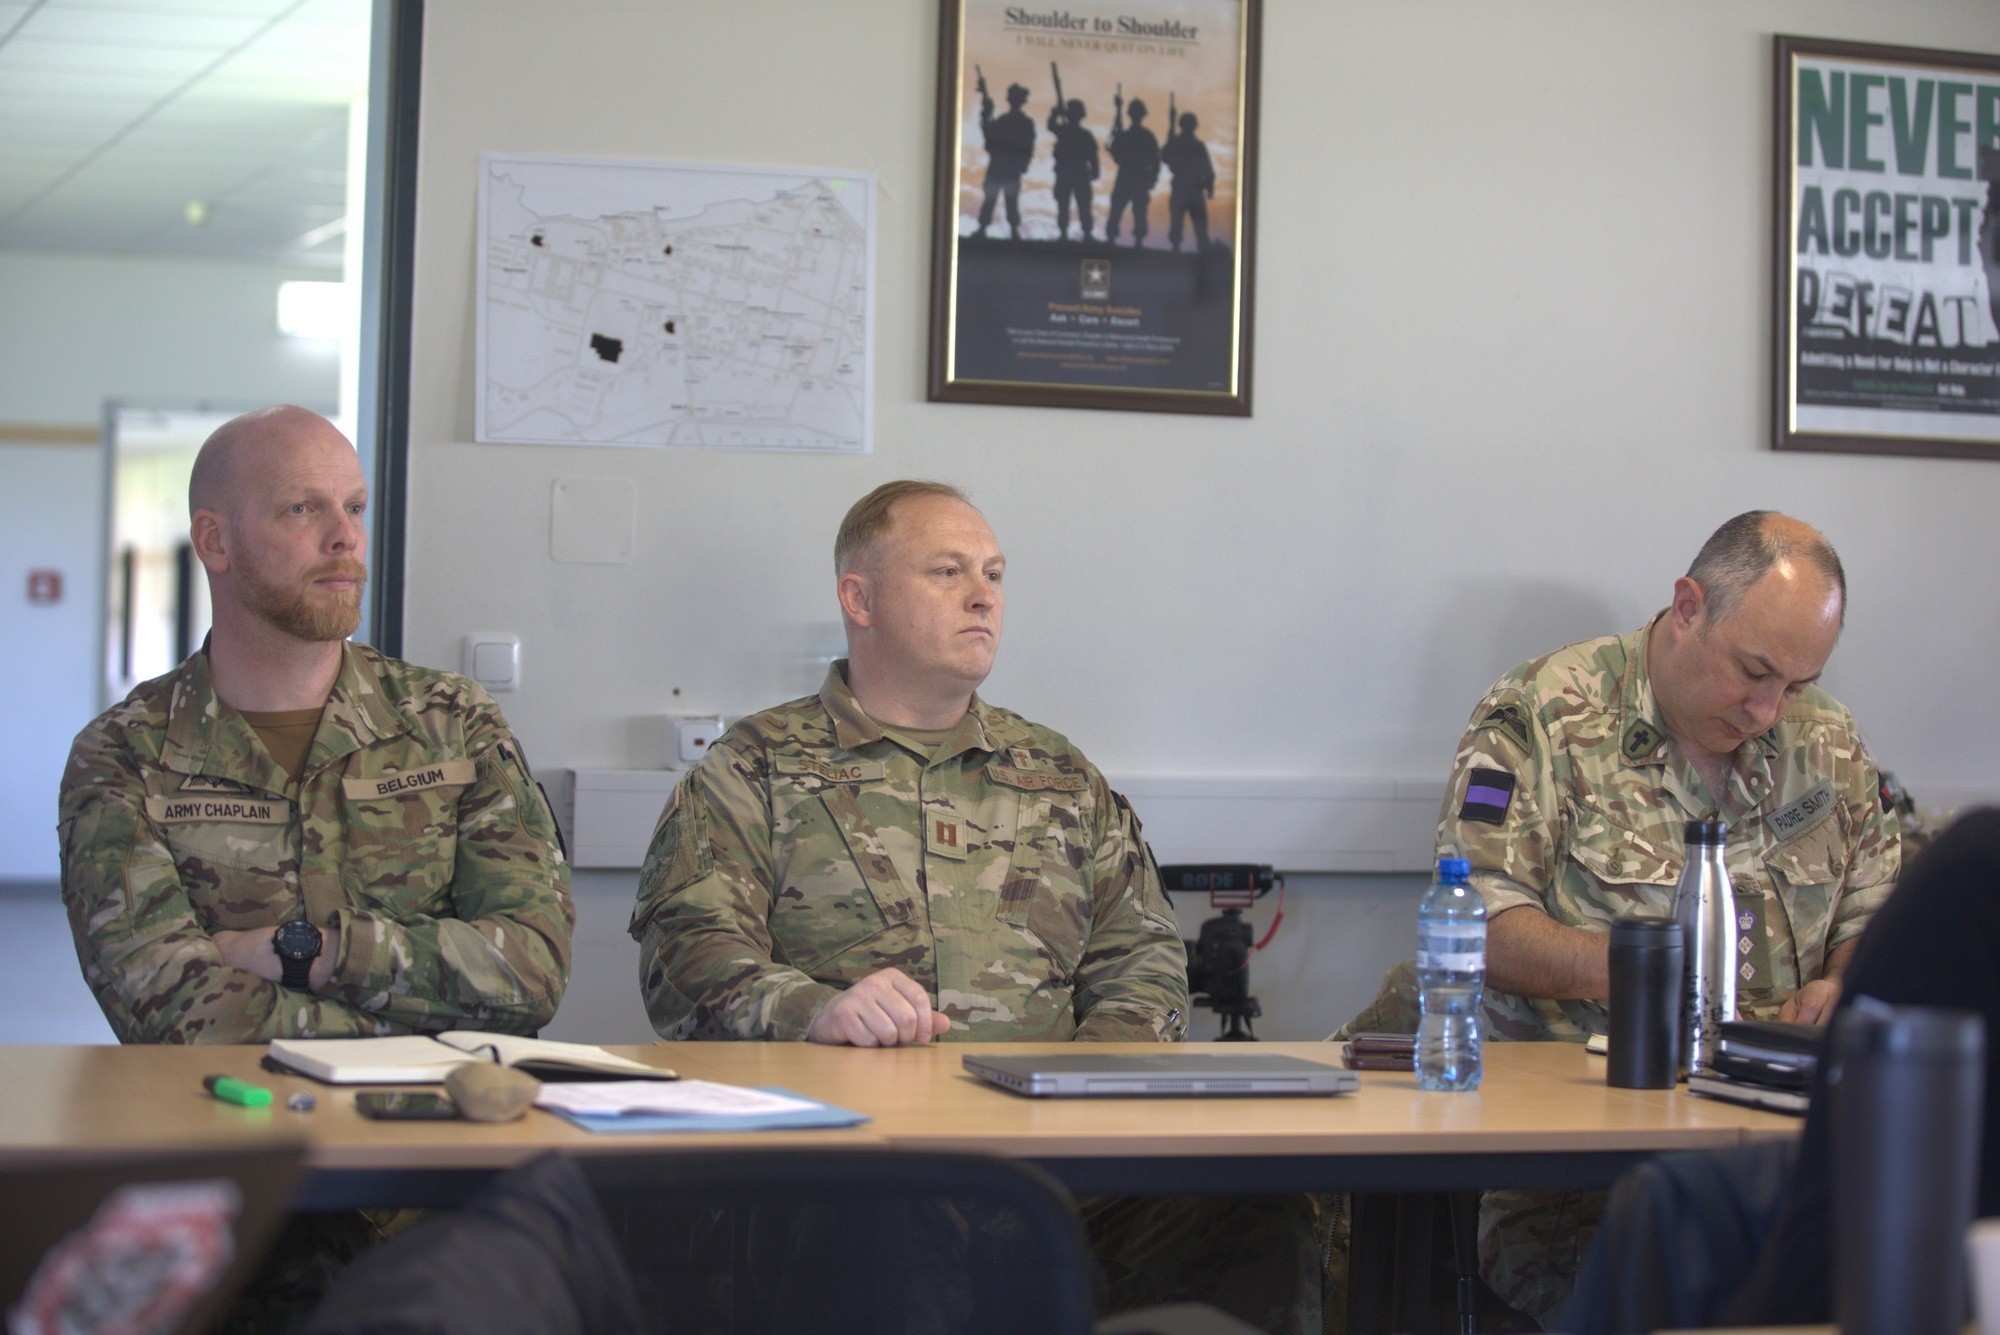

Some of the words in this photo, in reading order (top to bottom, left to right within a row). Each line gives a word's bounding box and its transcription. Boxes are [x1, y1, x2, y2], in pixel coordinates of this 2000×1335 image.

[1005, 6, 1088, 30] Shoulder
[1093, 15, 1112, 32] to
[1117, 14, 1199, 39] Shoulder
[1798, 185, 1979, 267] ACCEPT
[1798, 268, 1978, 347] DEFEAT
[376, 768, 445, 795] BELGIUM
[1016, 774, 1035, 788] AIR
[1039, 775, 1081, 789] FORCE
[165, 803, 202, 819] ARMY
[204, 803, 271, 819] CHAPLAIN
[1775, 807, 1804, 832] PADRE
[1802, 787, 1831, 815] SMITH
